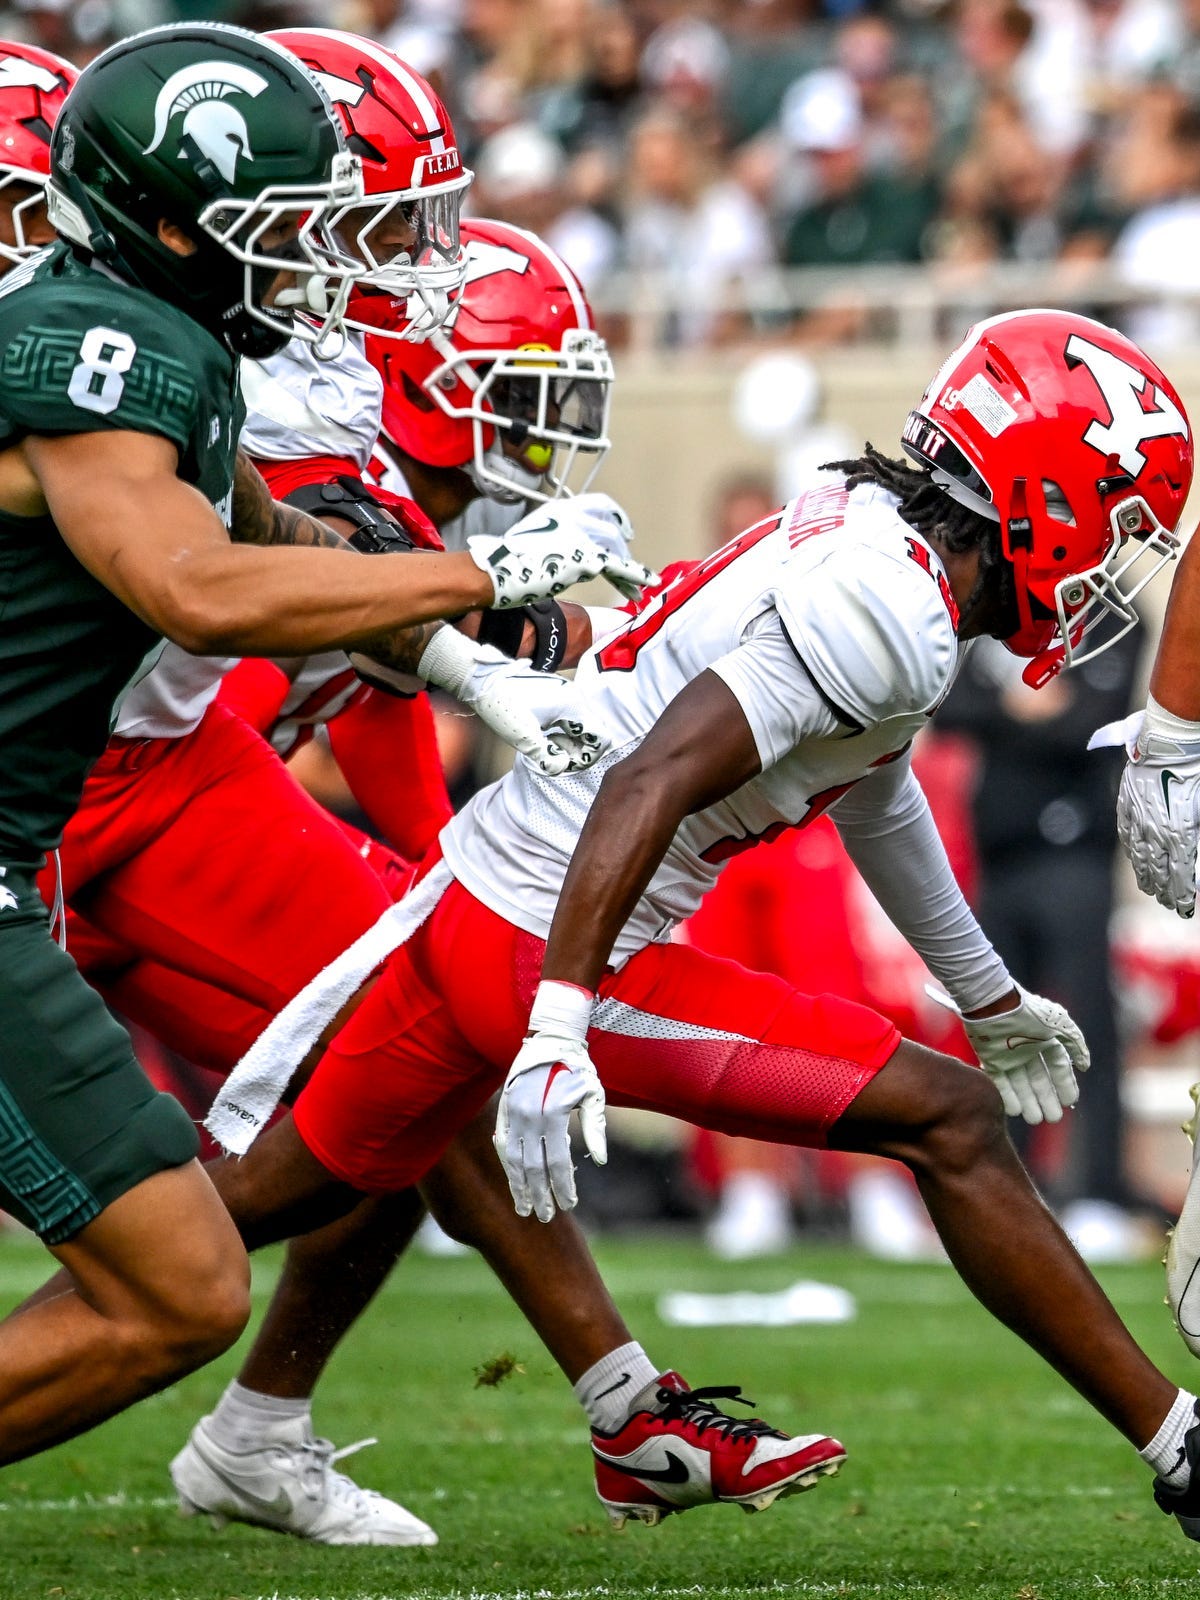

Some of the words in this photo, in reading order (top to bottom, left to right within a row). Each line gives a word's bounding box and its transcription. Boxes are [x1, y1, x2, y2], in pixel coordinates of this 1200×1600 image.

[67, 325, 137, 415] 8
[939, 386, 961, 411] 19
[571, 549, 584, 563] S
[519, 567, 533, 584] S
[541, 618, 560, 672] NJOY
